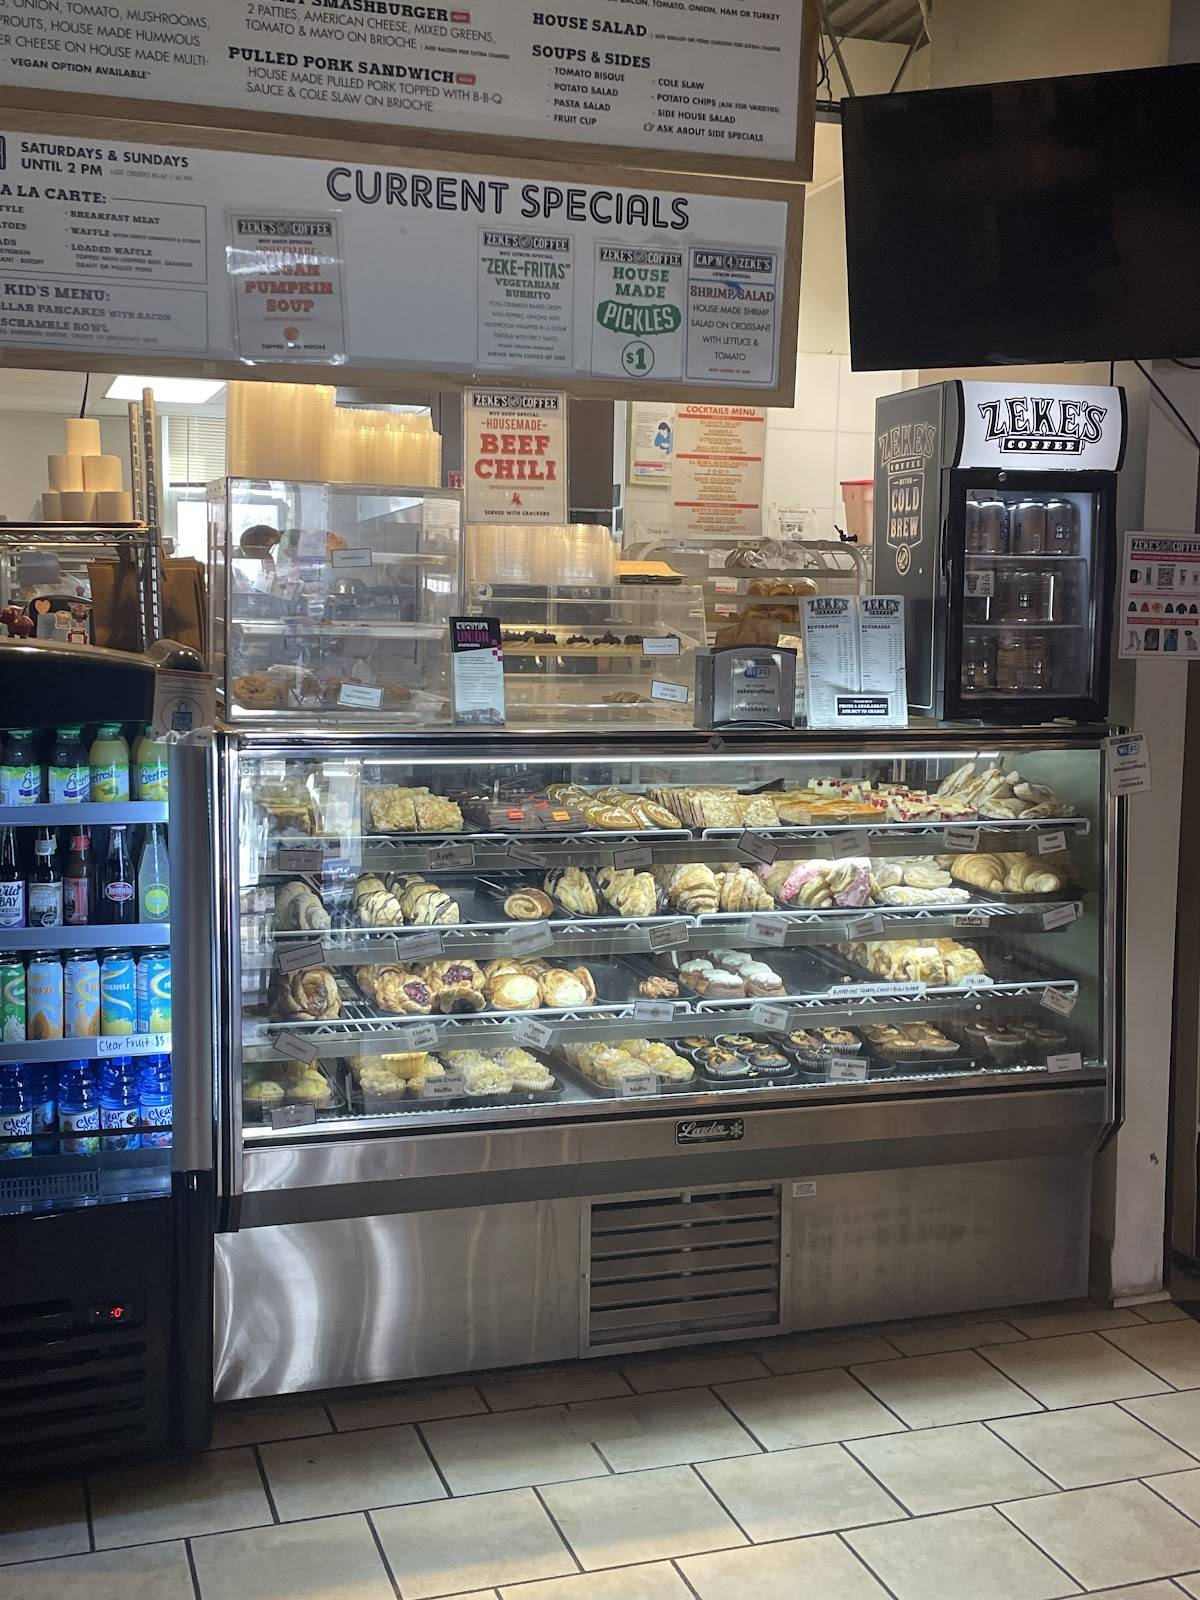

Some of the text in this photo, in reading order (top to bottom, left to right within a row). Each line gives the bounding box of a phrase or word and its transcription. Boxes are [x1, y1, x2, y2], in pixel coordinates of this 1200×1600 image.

[13, 0, 211, 30] ONION, TOMATO, MUSHROOMS,
[311, 0, 449, 21] SMASHBURGER
[719, 8, 737, 17] HAM
[739, 10, 750, 18] OR
[752, 11, 781, 21] TURKEY
[247, 3, 255, 14] 2
[303, 11, 365, 27] AMERICAN
[367, 18, 411, 34] CHEESE,
[413, 22, 448, 37] MIXED
[450, 27, 496, 44] GREENS,
[532, 12, 647, 37] HOUSE SALAD
[51, 20, 200, 48] HOUSE MADE HUMMOUS
[245, 18, 417, 49] TOMATO & MAYO ON BRIOCHE
[16, 36, 61, 52] CHEESE
[64, 41, 86, 54] ON
[90, 44, 132, 58] HOUSE
[135, 49, 169, 63] MADE
[532, 45, 651, 69] SOUPS & SIDES
[11, 57, 92, 74] VEGAN OPTION
[228, 46, 299, 67] PULLED
[303, 55, 354, 73] PORK
[357, 61, 455, 84] SANDWICH
[555, 67, 626, 82] TOMATO BISQUE
[247, 66, 503, 105] HOUSE MADE PULLED PORK TOPPED WITH B-B-Q
[554, 83, 619, 97] POTATO SALAD
[658, 78, 705, 90] COLE SLAW
[247, 82, 434, 112] SAUCE & COLE SLAW ON BRIOCHE
[554, 98, 611, 112] PASTA SALAD
[657, 93, 716, 107] POTATO CHIPS
[554, 114, 597, 126] FRUIT CUP
[657, 109, 736, 124] SIDE HOUSE SALAD
[657, 124, 764, 142] ASK ABOUT SIDE SPECIALS
[21, 142, 103, 160] SATURDAYS
[108, 150, 118, 162] &
[123, 152, 189, 168] SUNDAYS
[21, 158, 63, 173] UNTIL
[68, 162, 76, 174] 2
[81, 164, 103, 176] PM
[0, 184, 107, 204] A LA CARTE:
[327, 166, 690, 231] CURRENT SPECIALS
[70, 210, 160, 225] BREAKFAST MEAT
[71, 227, 110, 237] WAFFLE
[240, 222, 331, 235] ZEKE'S COFFEE
[487, 234, 570, 250] ZEKE'S COFFEE
[71, 244, 153, 257] LOADED WAFFLE
[602, 249, 682, 266] ZEKE'S COFFEE
[739, 257, 771, 271] ZEKE'S
[612, 266, 670, 283] HOUSE
[245, 281, 333, 295] PUMPKIN
[495, 277, 560, 290] VEGETARIAN
[615, 283, 666, 299] MADE
[4, 284, 110, 302] KID'S MENU:
[505, 289, 551, 300] BURRITO
[690, 284, 775, 302] SHRIMP SALAD
[38, 304, 106, 318] PANCAKES
[266, 299, 315, 312] SOUP
[693, 303, 719, 314] HOUSE
[720, 306, 741, 315] MADE
[0, 317, 110, 333] SCRAMBLE BOWL
[602, 305, 675, 332] PICKLES
[690, 318, 771, 333] SALAD ON CROISSANT
[702, 335, 722, 344] WITH
[722, 336, 752, 347] LETTUCE
[626, 347, 647, 370] $1
[714, 351, 746, 362] TOMATO
[475, 394, 558, 409] ZEKE'S COFFEE
[686, 405, 756, 416] COCKTAILS MENU
[977, 397, 1108, 444] ZEKE'S
[480, 433, 550, 456] BEEF
[878, 422, 937, 467] ZEKE'S
[1006, 440, 1076, 451] COFFEE
[474, 458, 556, 481] CHILI
[889, 460, 922, 472] COFFEE
[891, 487, 920, 512] COLD
[890, 517, 919, 538] BREW
[807, 598, 850, 612] ZEKE'S
[862, 598, 900, 612] ZEKE'S
[456, 630, 489, 643] UNION
[0, 896, 19, 907] BAY
[99, 1040, 123, 1053] Clear
